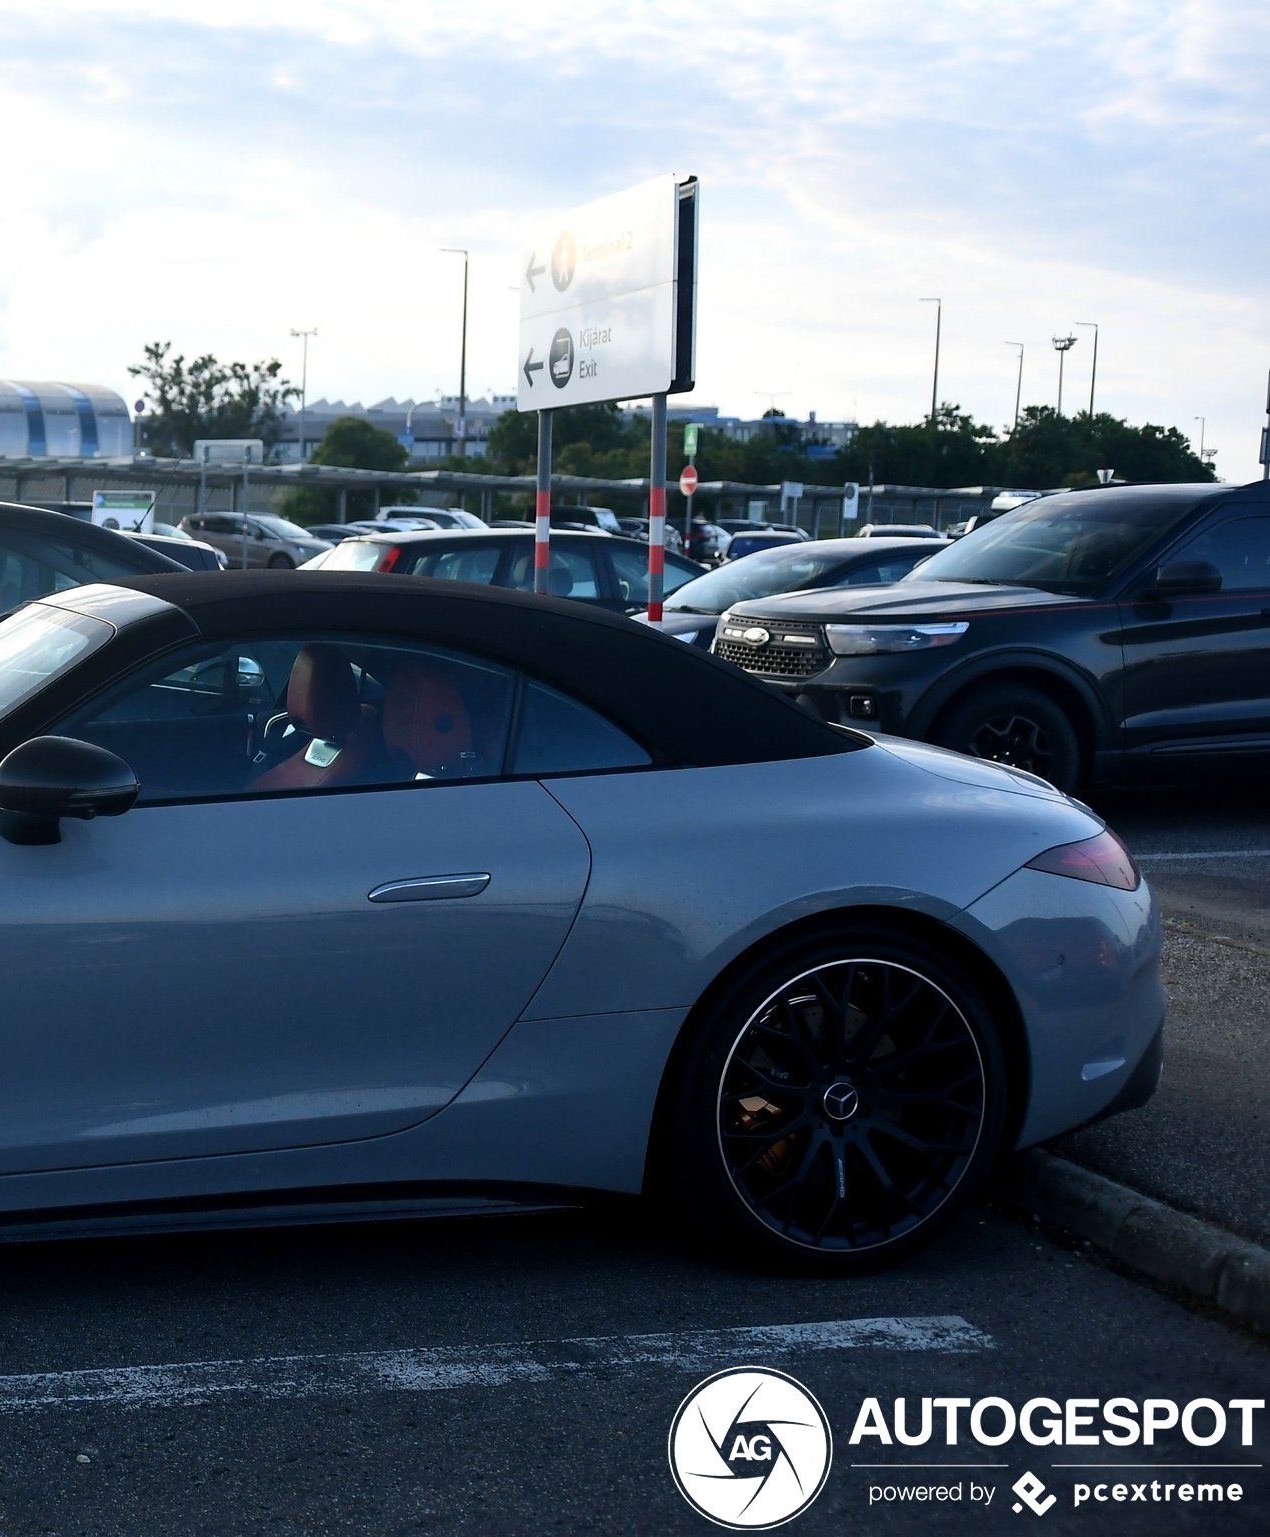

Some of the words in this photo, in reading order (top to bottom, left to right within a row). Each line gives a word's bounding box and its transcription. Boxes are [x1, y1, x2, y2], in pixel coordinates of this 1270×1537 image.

[582, 233, 624, 263] Terminal
[626, 230, 634, 251] 2
[579, 327, 612, 351] Kijárat
[579, 359, 598, 379] Exit
